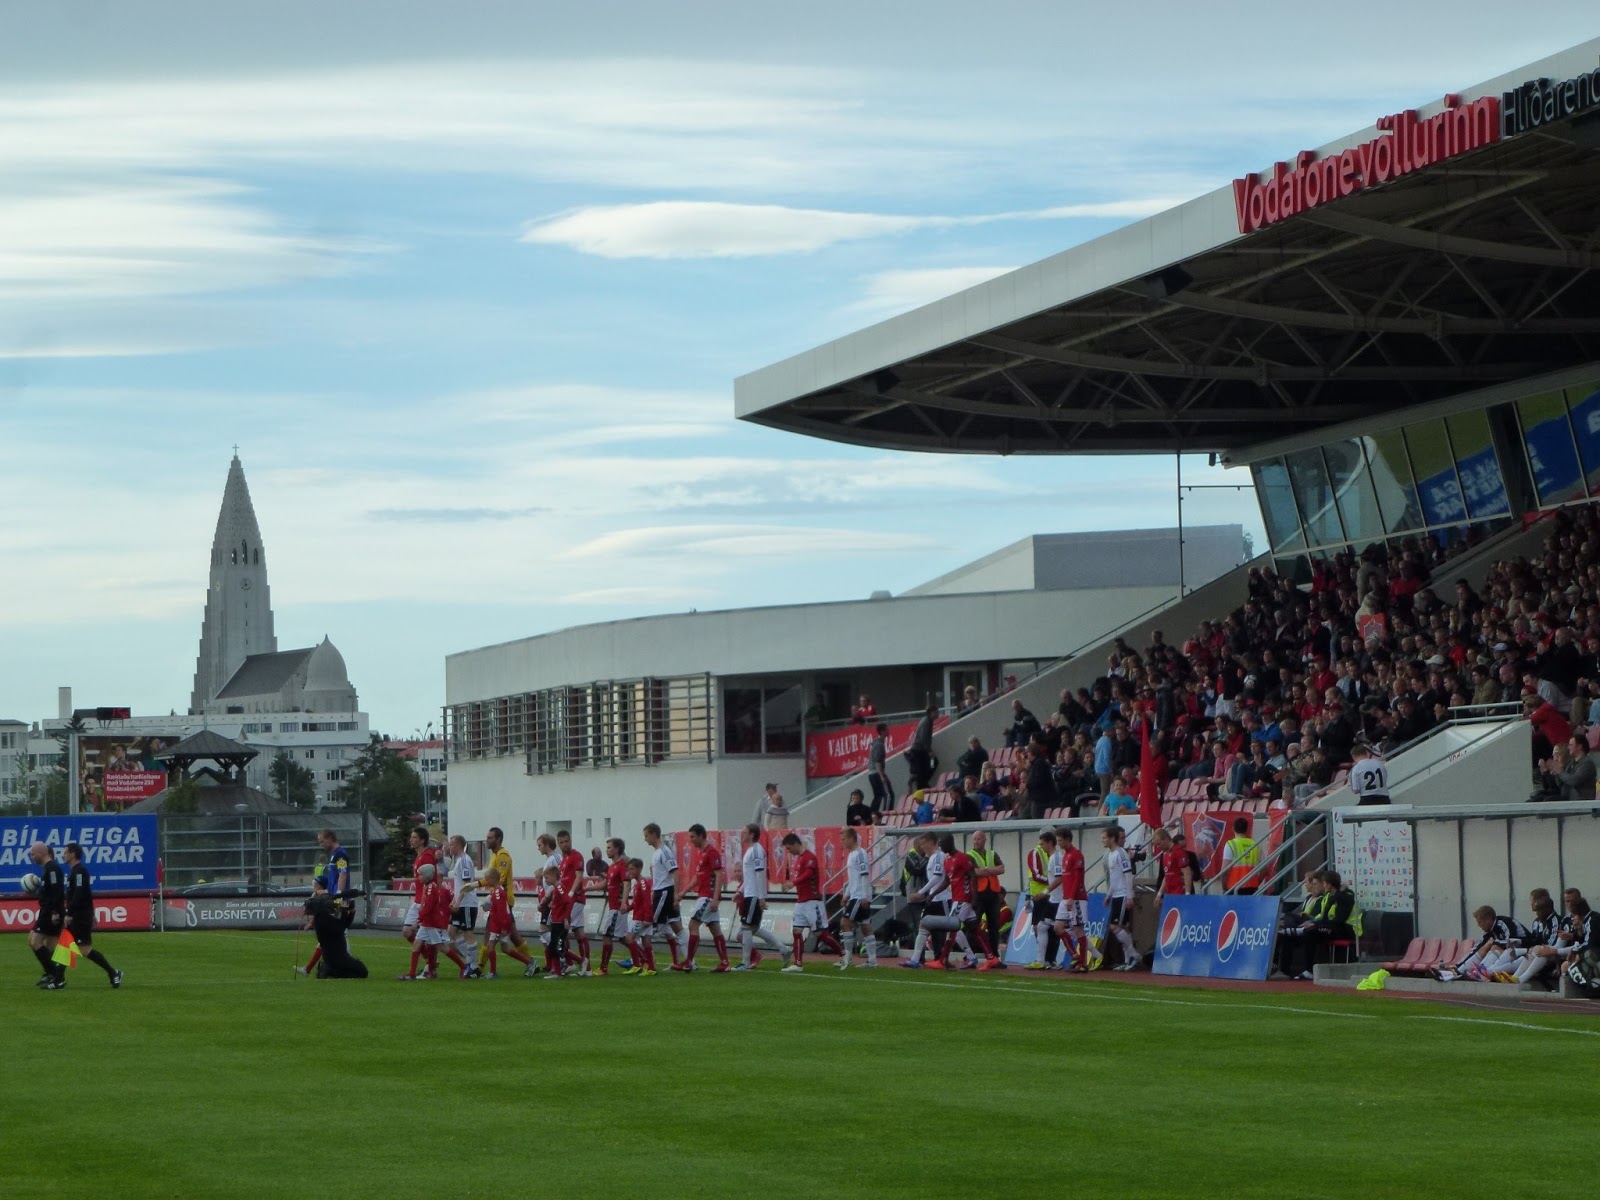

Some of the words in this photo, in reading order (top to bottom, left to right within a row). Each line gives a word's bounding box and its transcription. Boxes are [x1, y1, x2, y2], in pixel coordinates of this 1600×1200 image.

[1363, 768, 1384, 790] 21
[2, 825, 140, 847] BÍLALEIGA
[0, 845, 145, 866] AKRYRAR
[201, 909, 266, 920] ELDSNEYTI
[267, 908, 277, 919] Á
[1179, 921, 1212, 946] pepsi
[1236, 923, 1271, 950] pepsi
